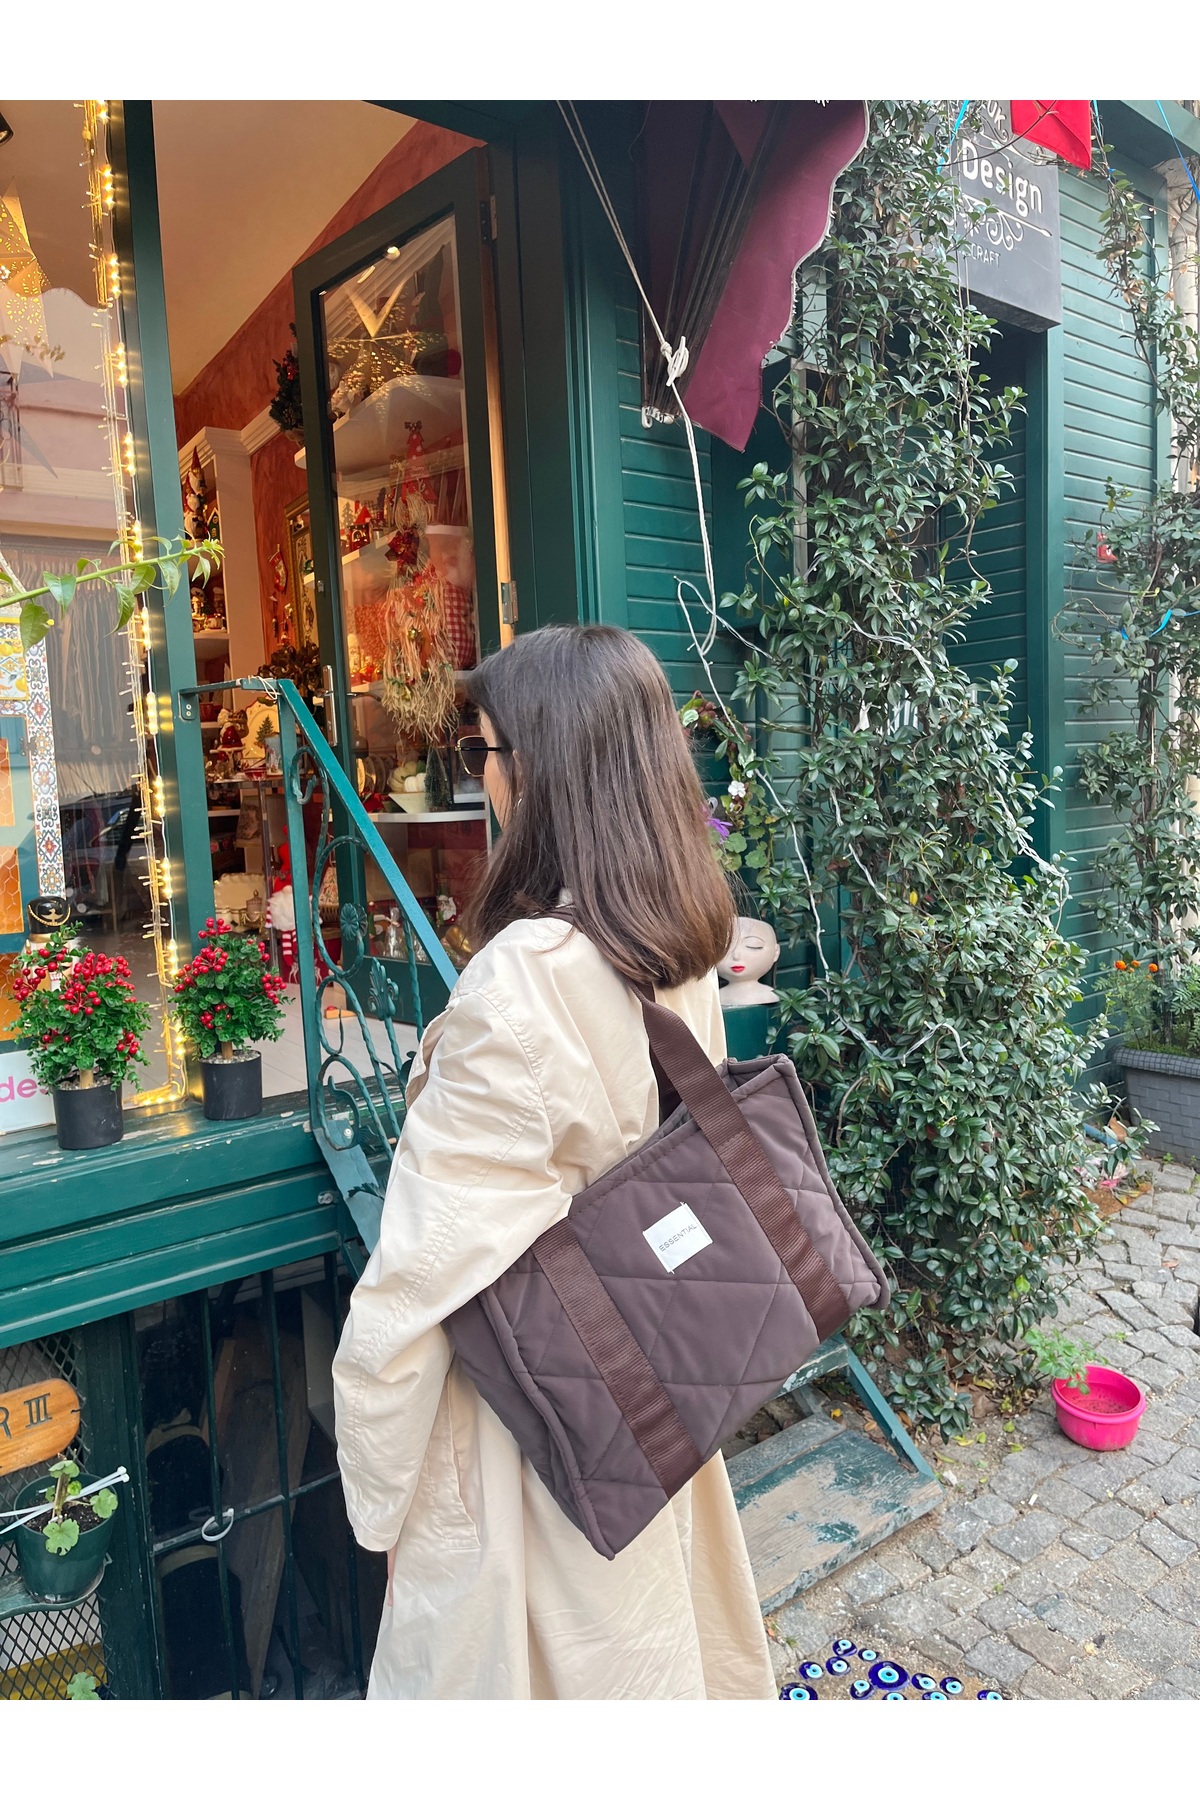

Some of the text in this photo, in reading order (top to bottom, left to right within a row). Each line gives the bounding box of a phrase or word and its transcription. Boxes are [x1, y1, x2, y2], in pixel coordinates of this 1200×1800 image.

[962, 138, 1043, 218] Design
[970, 243, 1001, 267] CRAFT
[0, 1075, 48, 1103] de
[658, 1223, 698, 1252] ESSENTIAL
[23, 1392, 53, 1429] III
